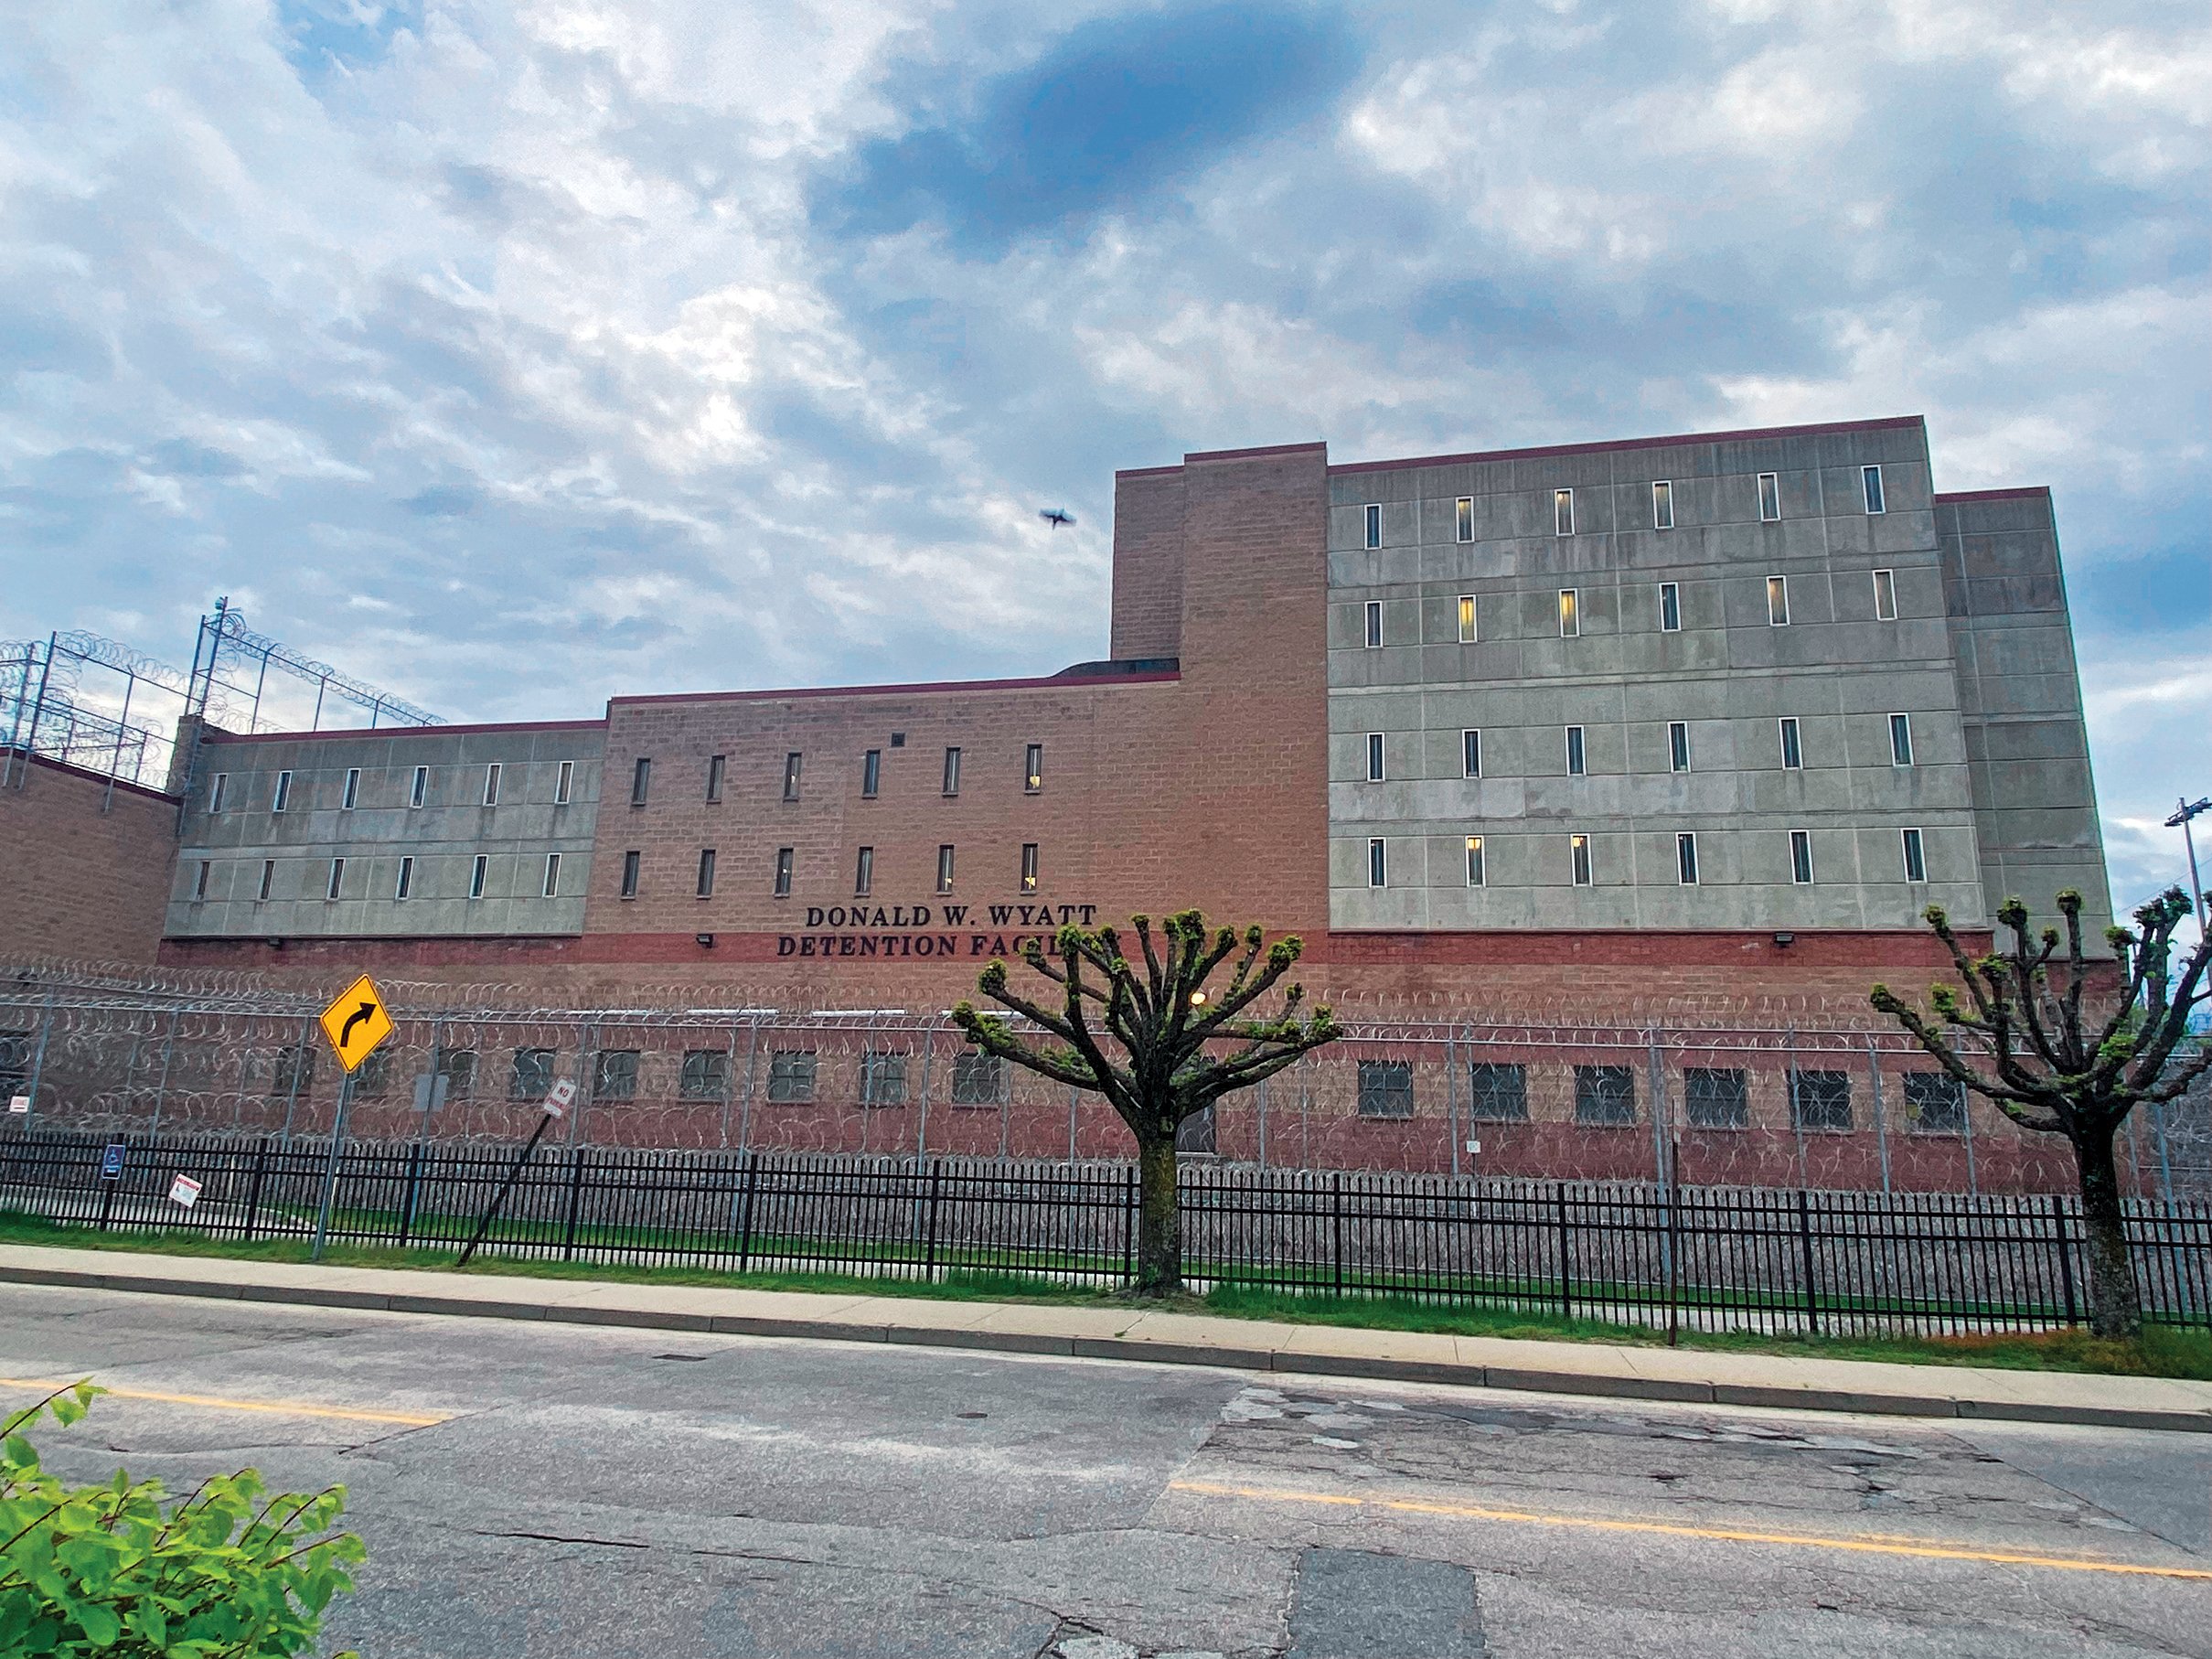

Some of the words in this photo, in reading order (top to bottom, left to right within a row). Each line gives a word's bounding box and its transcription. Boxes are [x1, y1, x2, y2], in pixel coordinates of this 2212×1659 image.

[806, 905, 931, 927] DONALD
[943, 905, 976, 926] W.
[988, 904, 1096, 926] WYATT
[778, 936, 956, 957] DETENTION
[970, 935, 1121, 956] FACIL
[558, 1086, 569, 1097] NO
